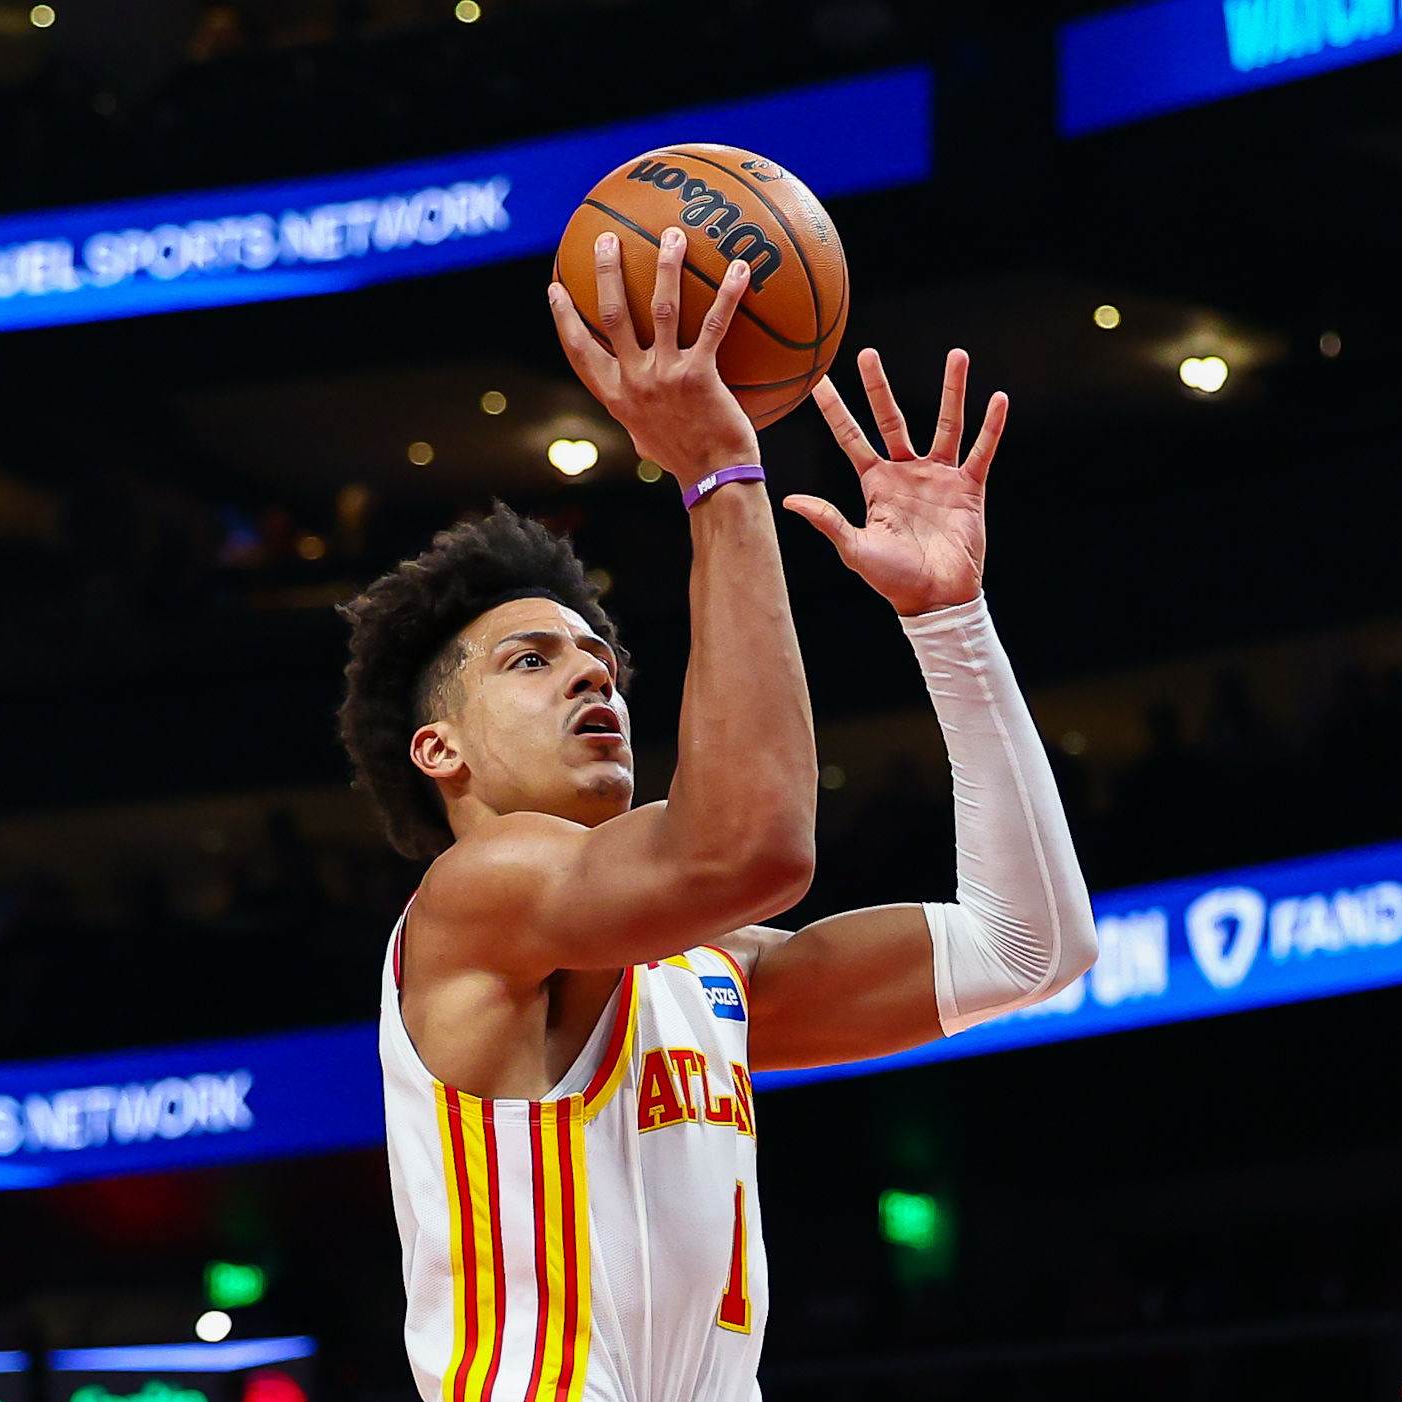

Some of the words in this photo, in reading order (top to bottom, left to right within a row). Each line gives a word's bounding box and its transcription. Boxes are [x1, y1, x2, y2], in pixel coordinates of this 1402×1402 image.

[83, 212, 280, 288] SPORTS
[280, 175, 510, 264] NETWORK
[626, 159, 782, 294] Wilson
[24, 1070, 253, 1152] NETWORK
[716, 1178, 751, 1335] 1
